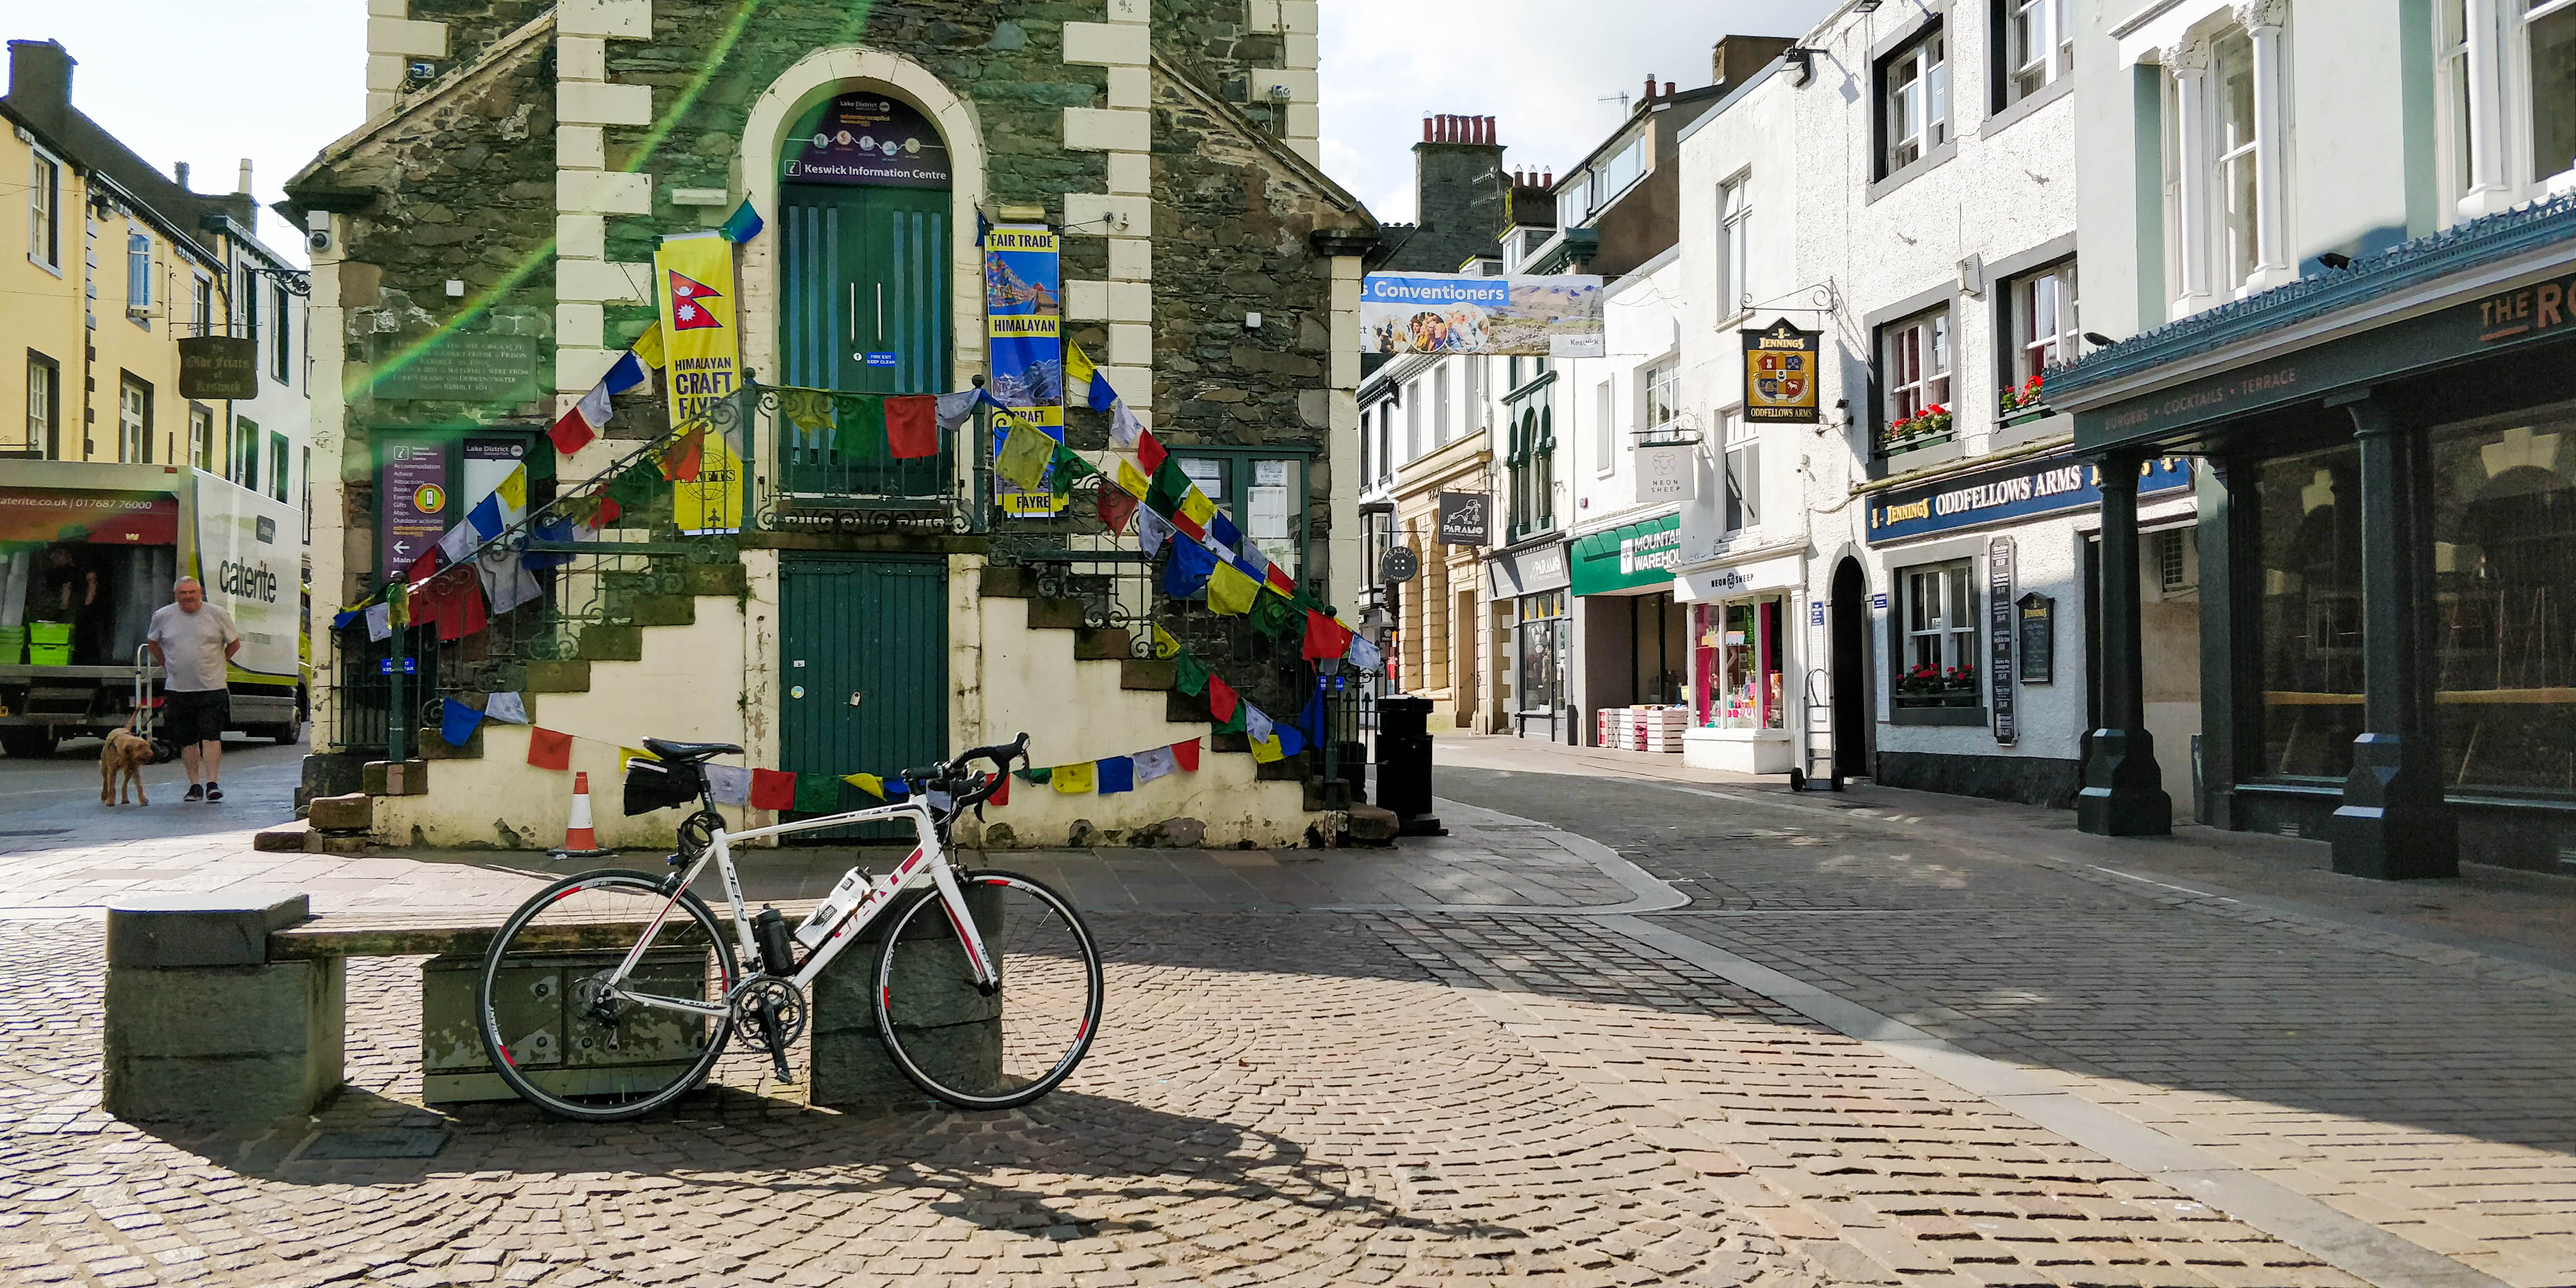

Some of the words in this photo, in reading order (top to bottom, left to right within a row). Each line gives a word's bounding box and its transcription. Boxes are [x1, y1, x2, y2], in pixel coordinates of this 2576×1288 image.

[804, 164, 847, 174] Keswick
[849, 165, 910, 178] Information
[912, 169, 947, 180] Centre
[991, 234, 1016, 247] FAIR
[1017, 235, 1053, 248] TRADE
[1374, 281, 1505, 301] Conventioners
[2480, 291, 2531, 327] THE
[994, 319, 1055, 332] HIMALAYAN
[1759, 337, 1805, 349] JENNINGS
[675, 357, 732, 372] HIMALAYAN
[675, 371, 732, 395] CRAFT
[2105, 408, 2149, 431] BURGERS
[2164, 388, 2223, 415] COCKTAILS
[2242, 367, 2296, 395] TERRACE
[1750, 408, 1793, 418] ODDFELLOWS
[1794, 409, 1812, 418] ARMS
[1016, 496, 1049, 508] FAYRE
[1886, 498, 1930, 527] JENNINGS
[1935, 476, 2031, 517] ODDFELLOWS
[2034, 465, 2083, 497] ARMS
[75, 499, 116, 508] 017687
[119, 500, 152, 510] 76000
[1386, 548, 1414, 560] SEASALT
[220, 558, 277, 604] caterite
[1711, 577, 1726, 588] NEON
[1735, 574, 1754, 584] SHEEP
[885, 946, 895, 974] GIANT
